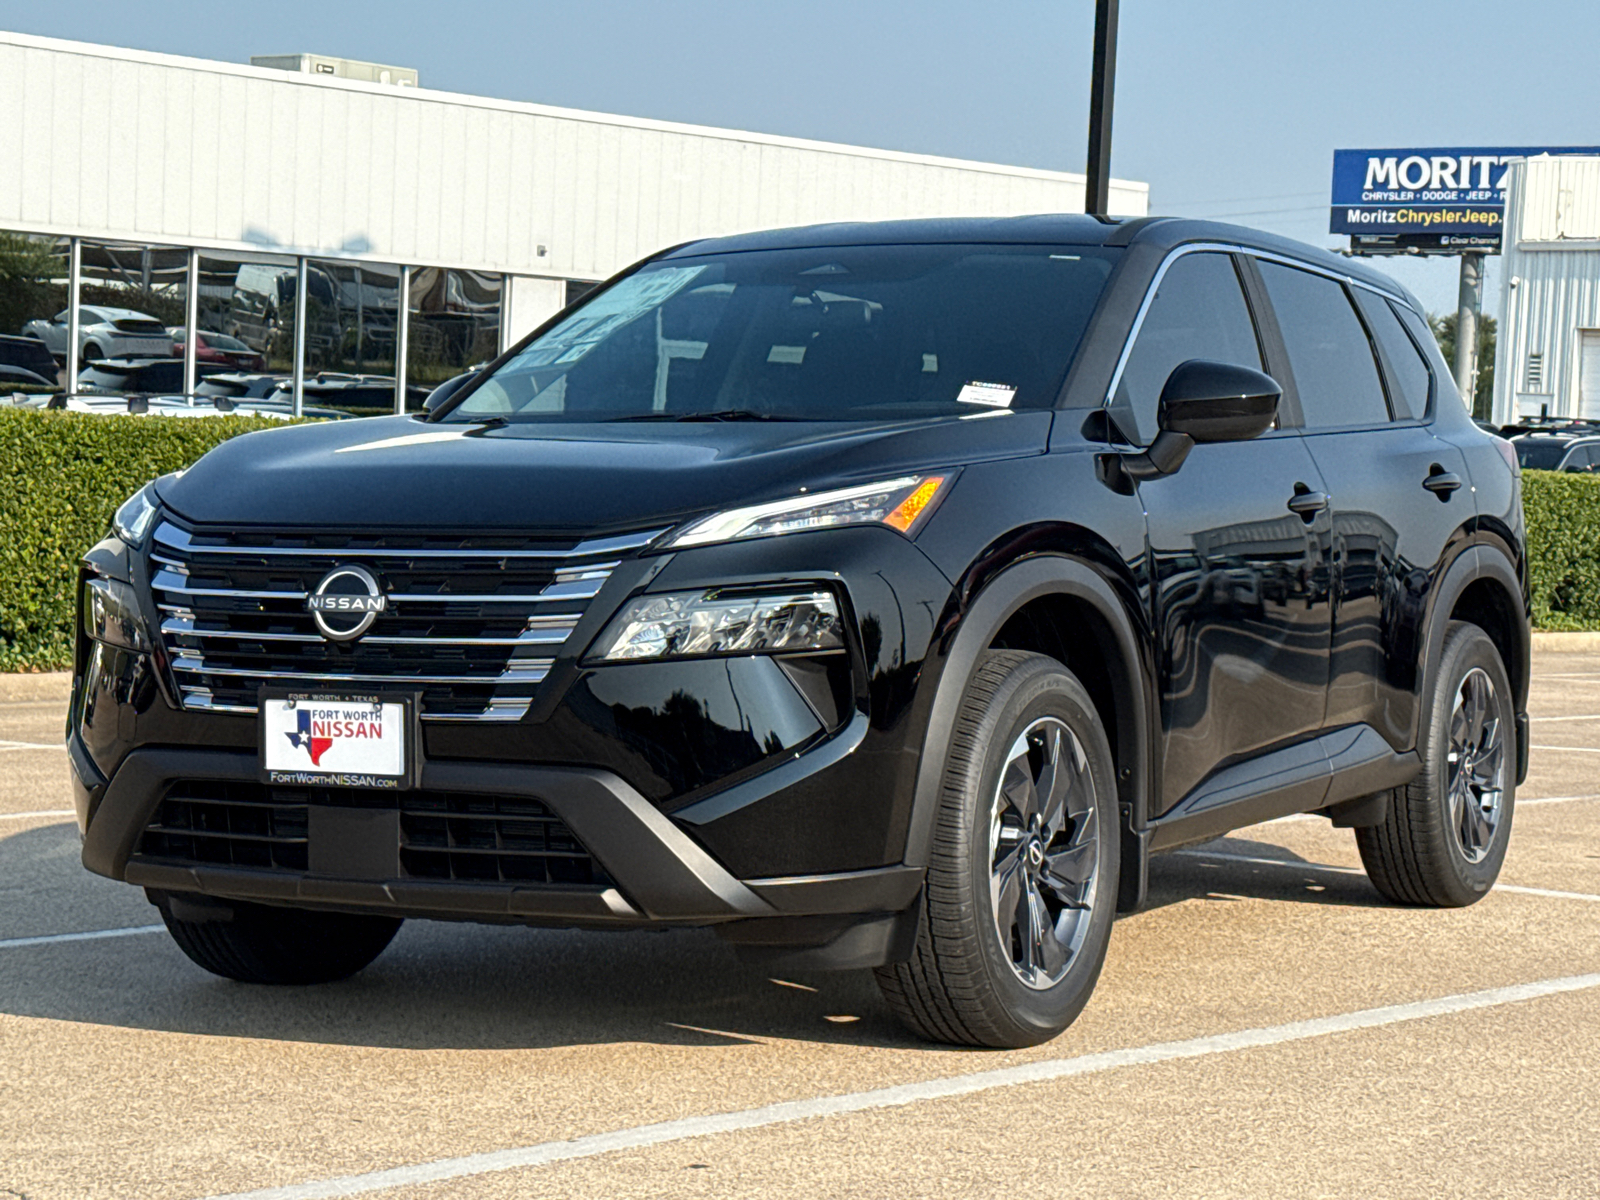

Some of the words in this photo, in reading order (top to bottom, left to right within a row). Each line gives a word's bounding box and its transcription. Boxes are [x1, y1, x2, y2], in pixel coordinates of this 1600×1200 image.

[1363, 155, 1518, 190] MORITZ
[1361, 191, 1415, 201] CHRYSLER
[1422, 191, 1459, 201] DODGE
[1465, 190, 1492, 201] JEEP
[1470, 237, 1500, 246] Channel
[308, 597, 382, 610] NISSAN
[288, 693, 309, 701] FORT
[312, 694, 341, 702] WORTH
[352, 695, 379, 703] TEXAS
[312, 709, 340, 721] FORT
[343, 710, 383, 722] WORTH
[312, 721, 383, 740] NISSAN
